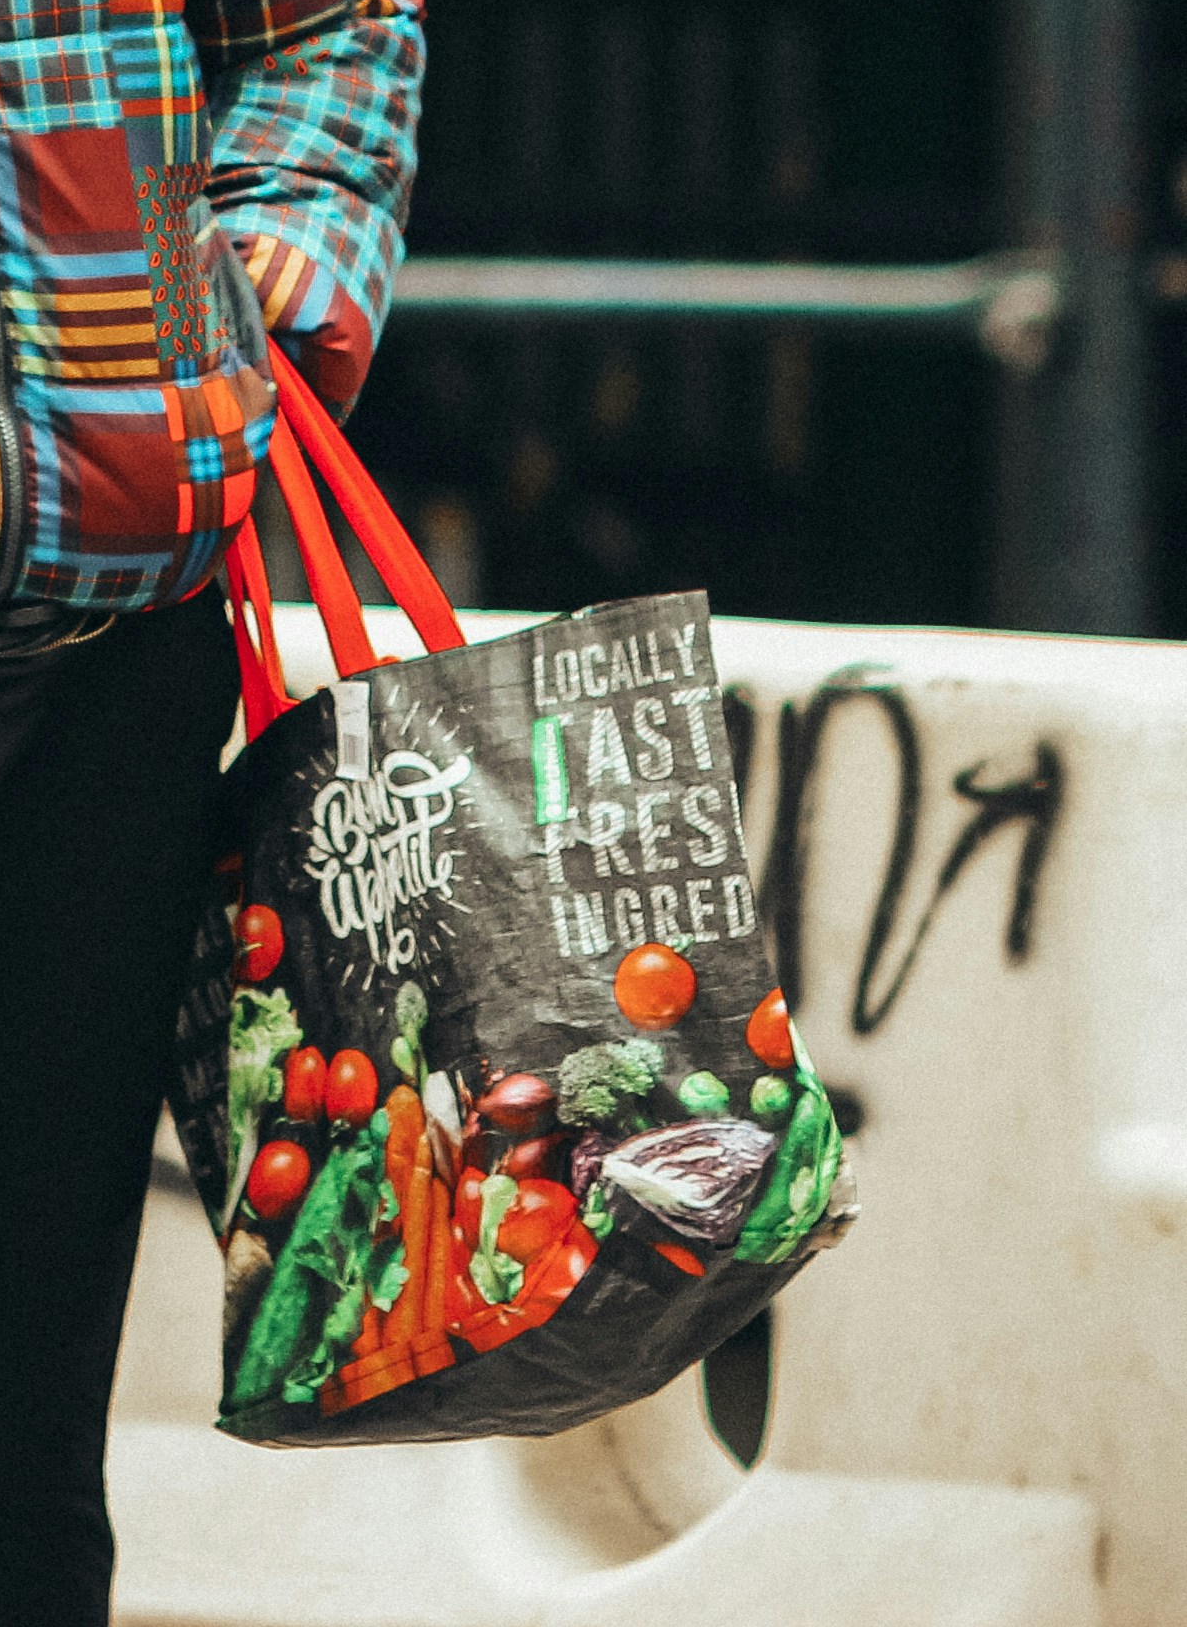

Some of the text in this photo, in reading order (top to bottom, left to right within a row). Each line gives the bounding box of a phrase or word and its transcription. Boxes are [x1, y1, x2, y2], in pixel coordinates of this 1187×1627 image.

[533, 624, 696, 709] LOCALLY
[559, 686, 722, 788] AST
[544, 781, 748, 884] FRES
